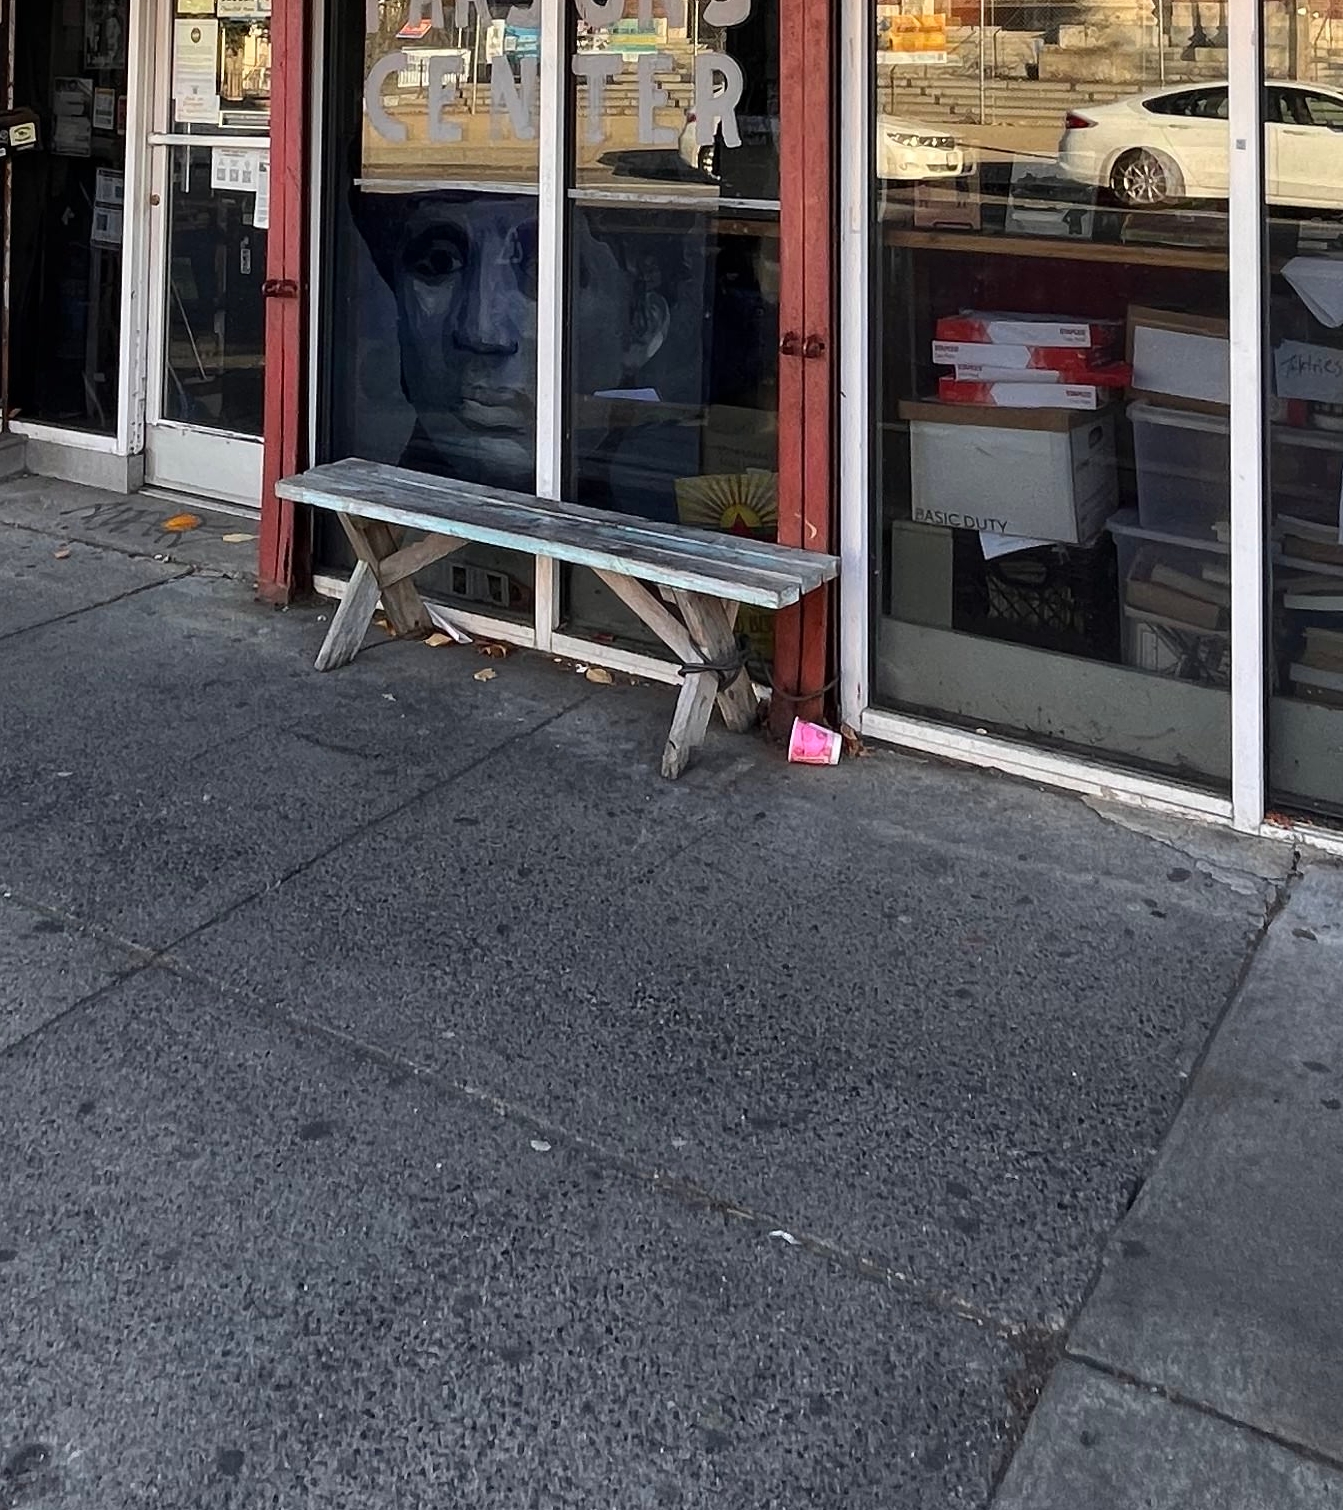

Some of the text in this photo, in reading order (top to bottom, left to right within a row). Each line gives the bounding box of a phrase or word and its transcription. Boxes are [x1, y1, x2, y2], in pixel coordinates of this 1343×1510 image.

[364, 51, 744, 148] CENTER
[915, 507, 1008, 534] BASIC DUTY
